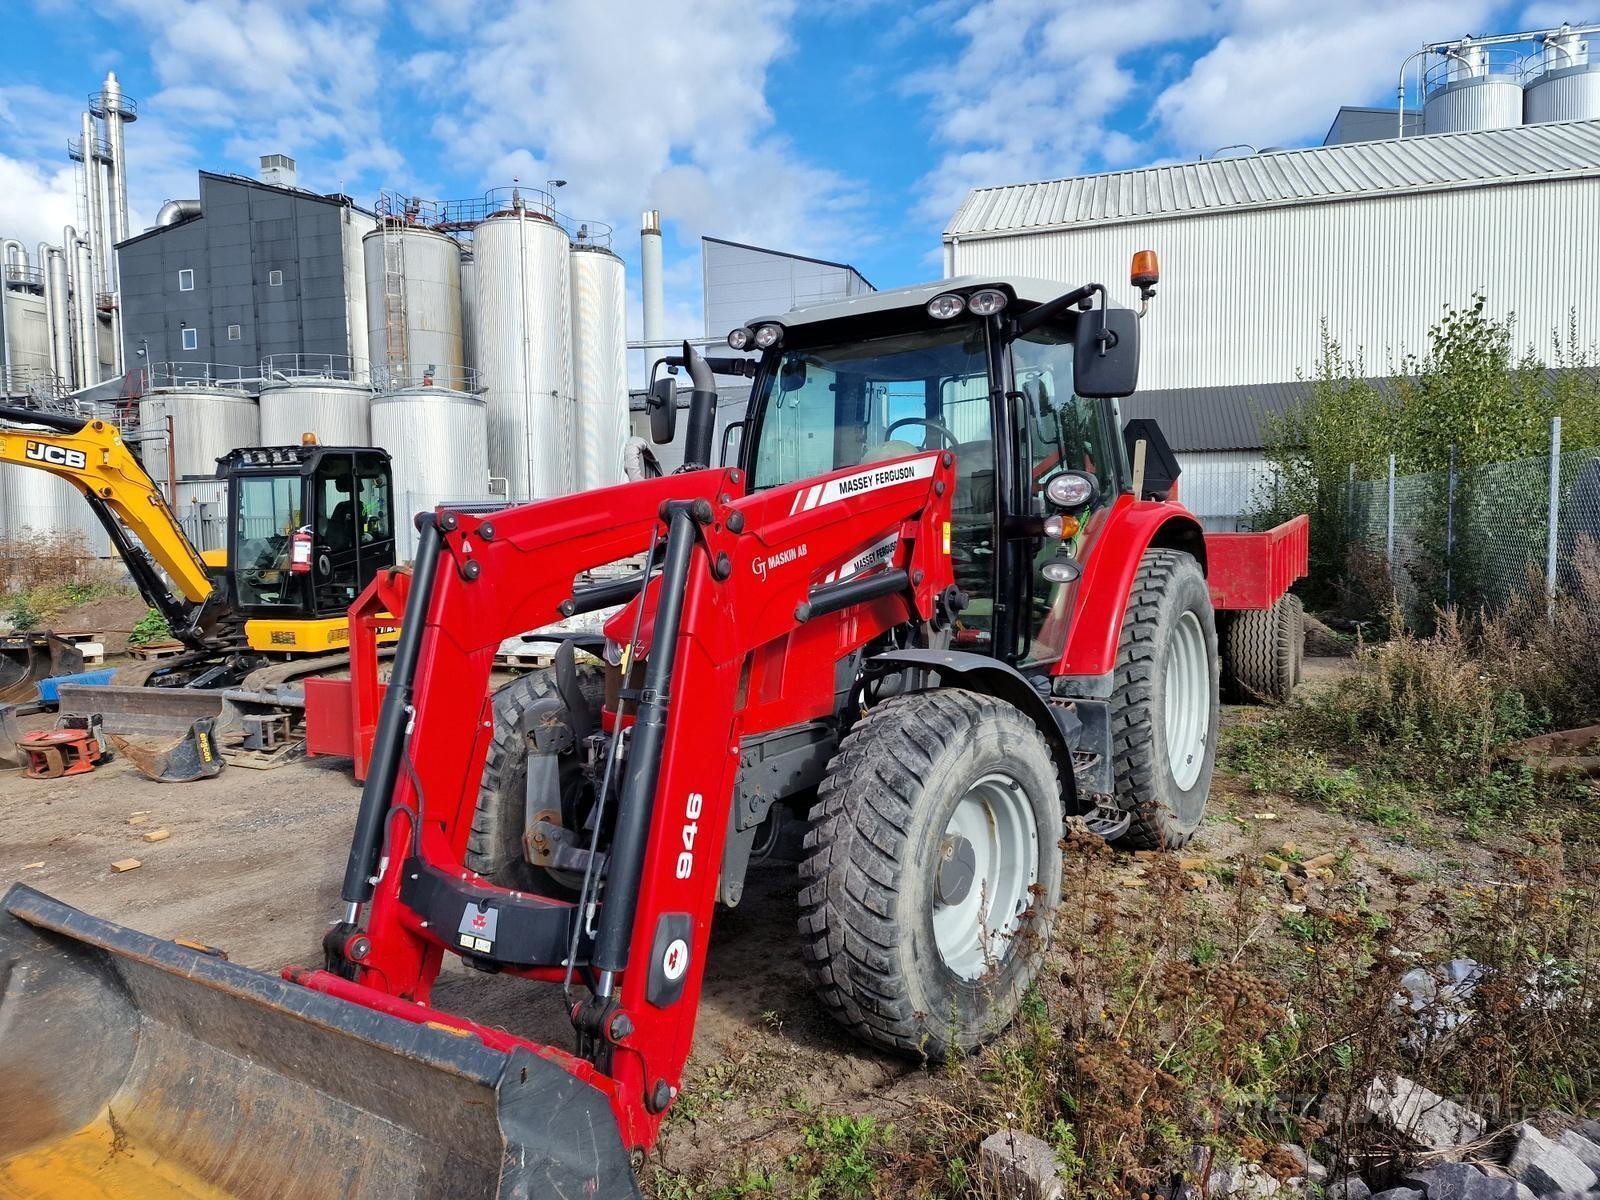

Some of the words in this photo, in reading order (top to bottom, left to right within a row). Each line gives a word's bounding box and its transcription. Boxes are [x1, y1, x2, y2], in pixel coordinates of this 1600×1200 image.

[27, 442, 86, 468] JCB
[839, 475, 873, 494] MASSEY
[875, 466, 915, 486] FERGUSON
[768, 547, 797, 569] MASKIN
[797, 543, 808, 558] AB
[853, 551, 876, 570] MASSEY
[199, 732, 211, 762] engcon
[676, 792, 703, 880] 946
